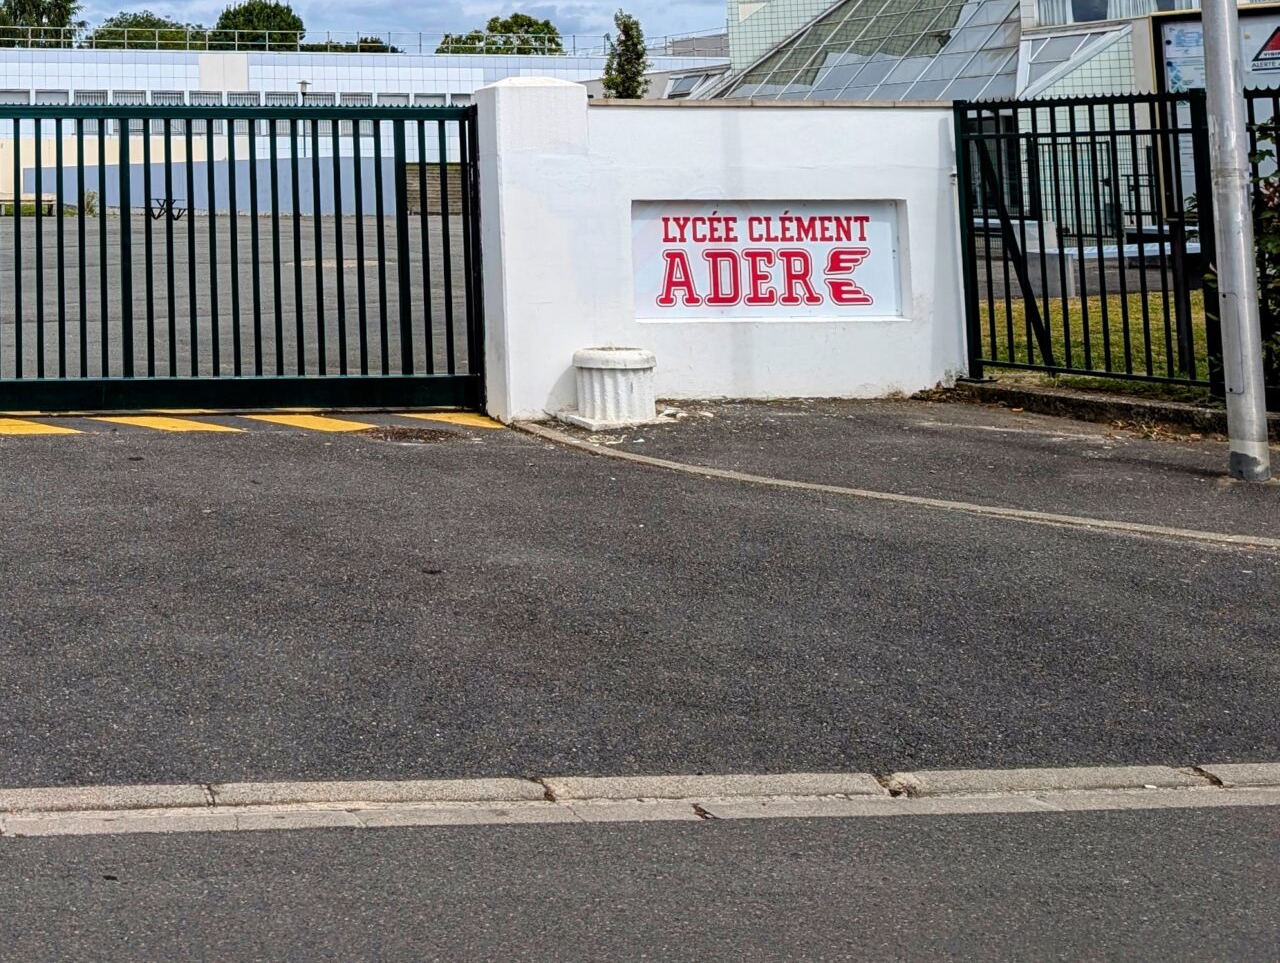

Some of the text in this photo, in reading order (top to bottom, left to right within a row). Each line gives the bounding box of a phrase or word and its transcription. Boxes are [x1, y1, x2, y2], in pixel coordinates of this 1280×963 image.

[662, 211, 870, 243] LYCÉE CLÉMENT
[656, 248, 823, 307] ADER
